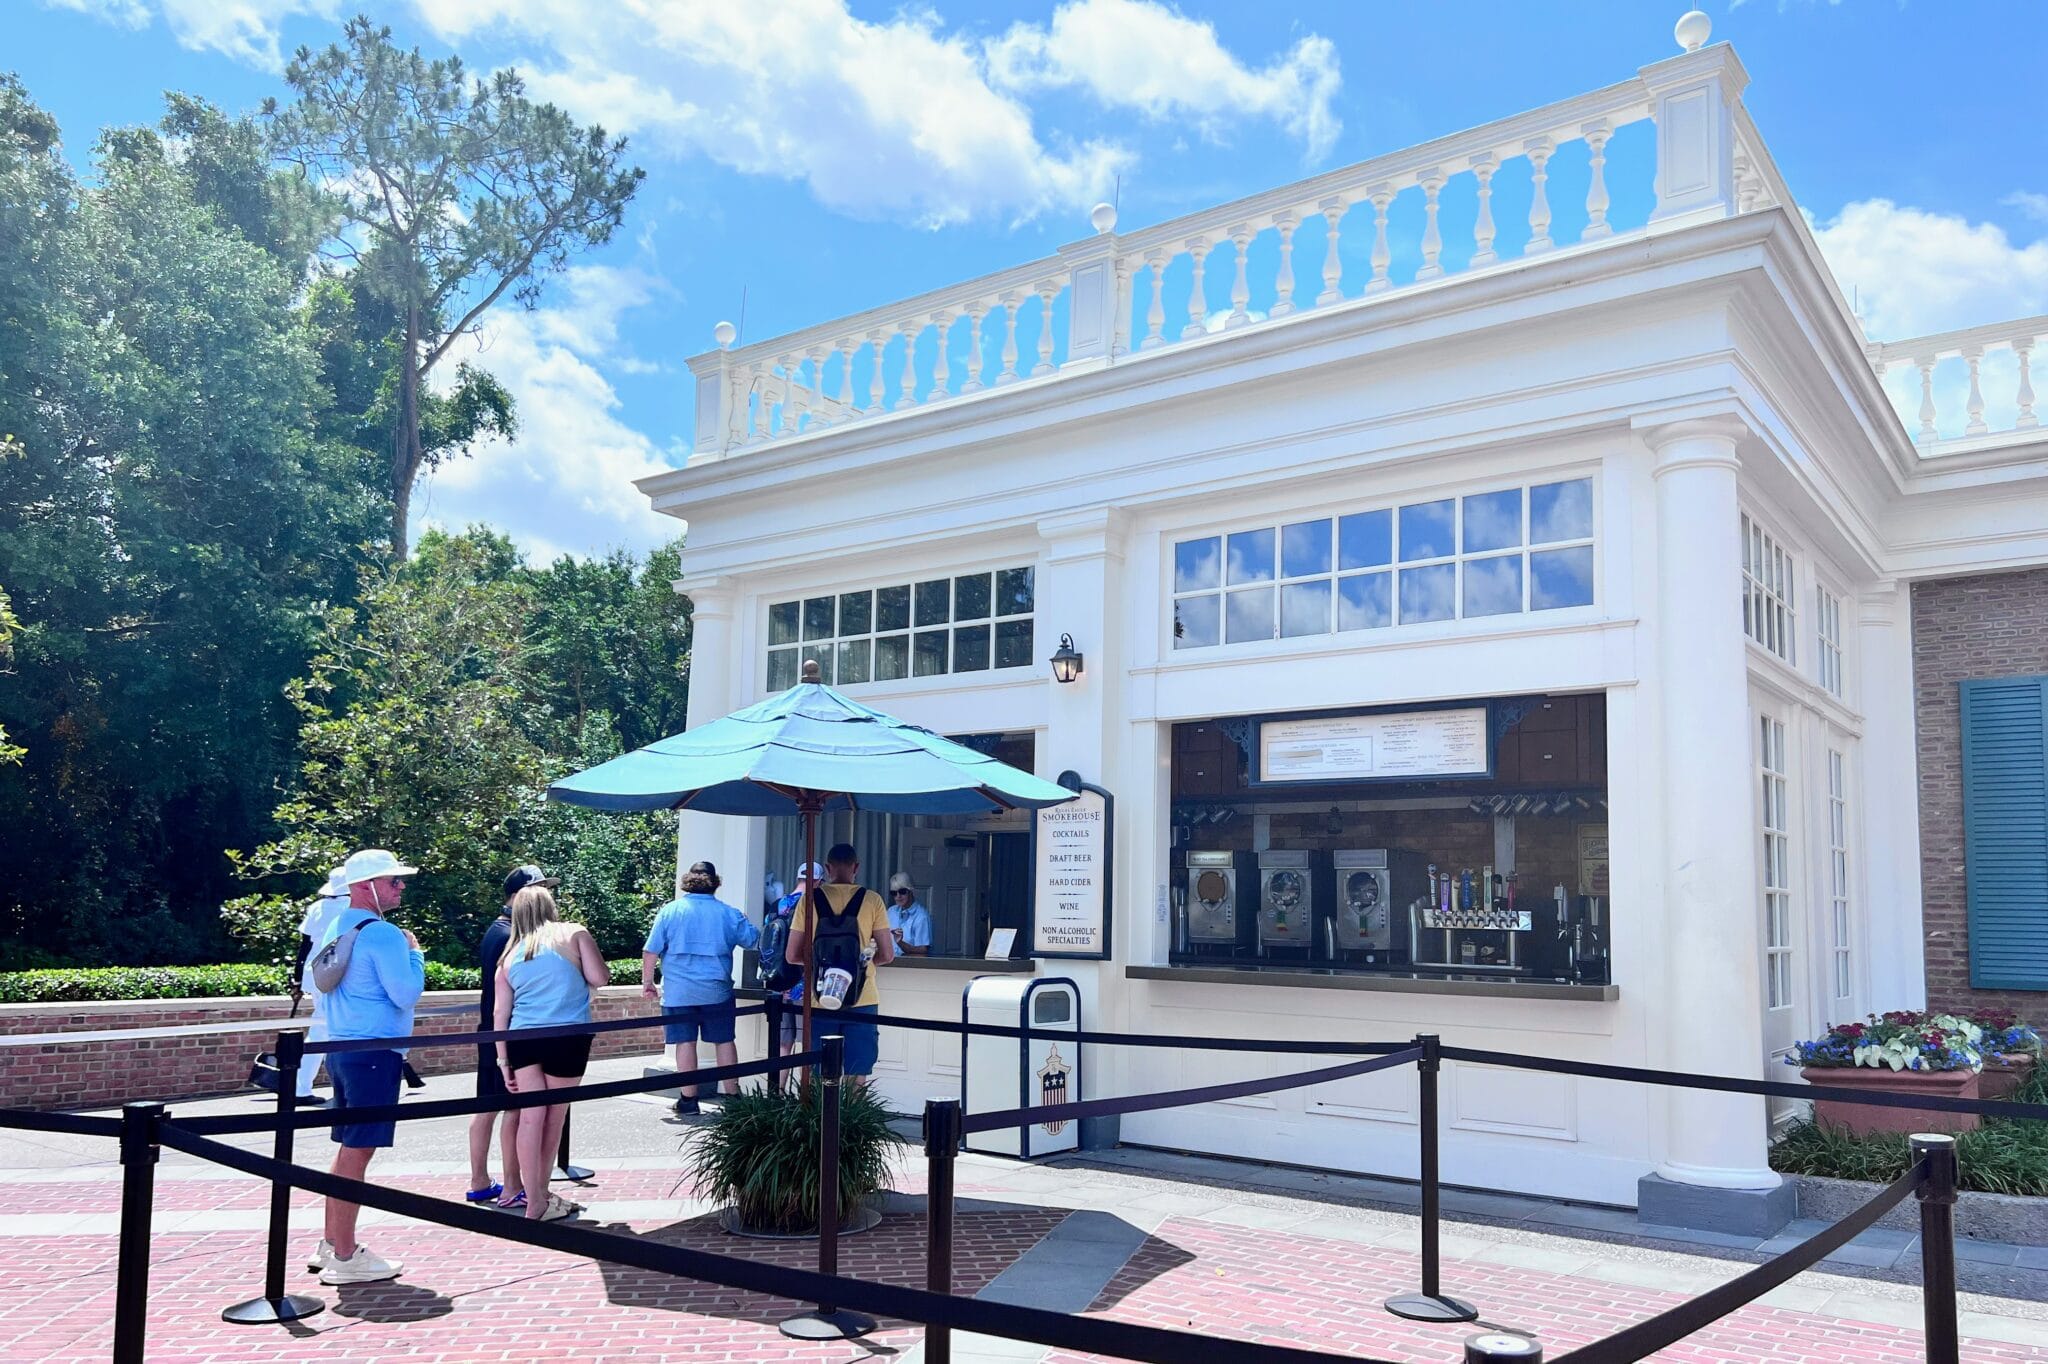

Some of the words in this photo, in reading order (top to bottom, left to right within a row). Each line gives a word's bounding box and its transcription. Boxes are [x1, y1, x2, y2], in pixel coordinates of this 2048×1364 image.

[1042, 811, 1101, 822] SMOKEHOUSE
[1052, 830, 1090, 838] COCKTAILS
[1049, 854, 1073, 863] DRAFT
[1074, 854, 1092, 862] BEER
[1049, 878, 1070, 886] HARD
[1070, 878, 1091, 886] CIDER
[1059, 902, 1080, 910] WINE
[1042, 926, 1057, 934] NON
[1058, 927, 1096, 935] ALCOHOLIC
[1047, 936, 1090, 944] SPECIALTIES
